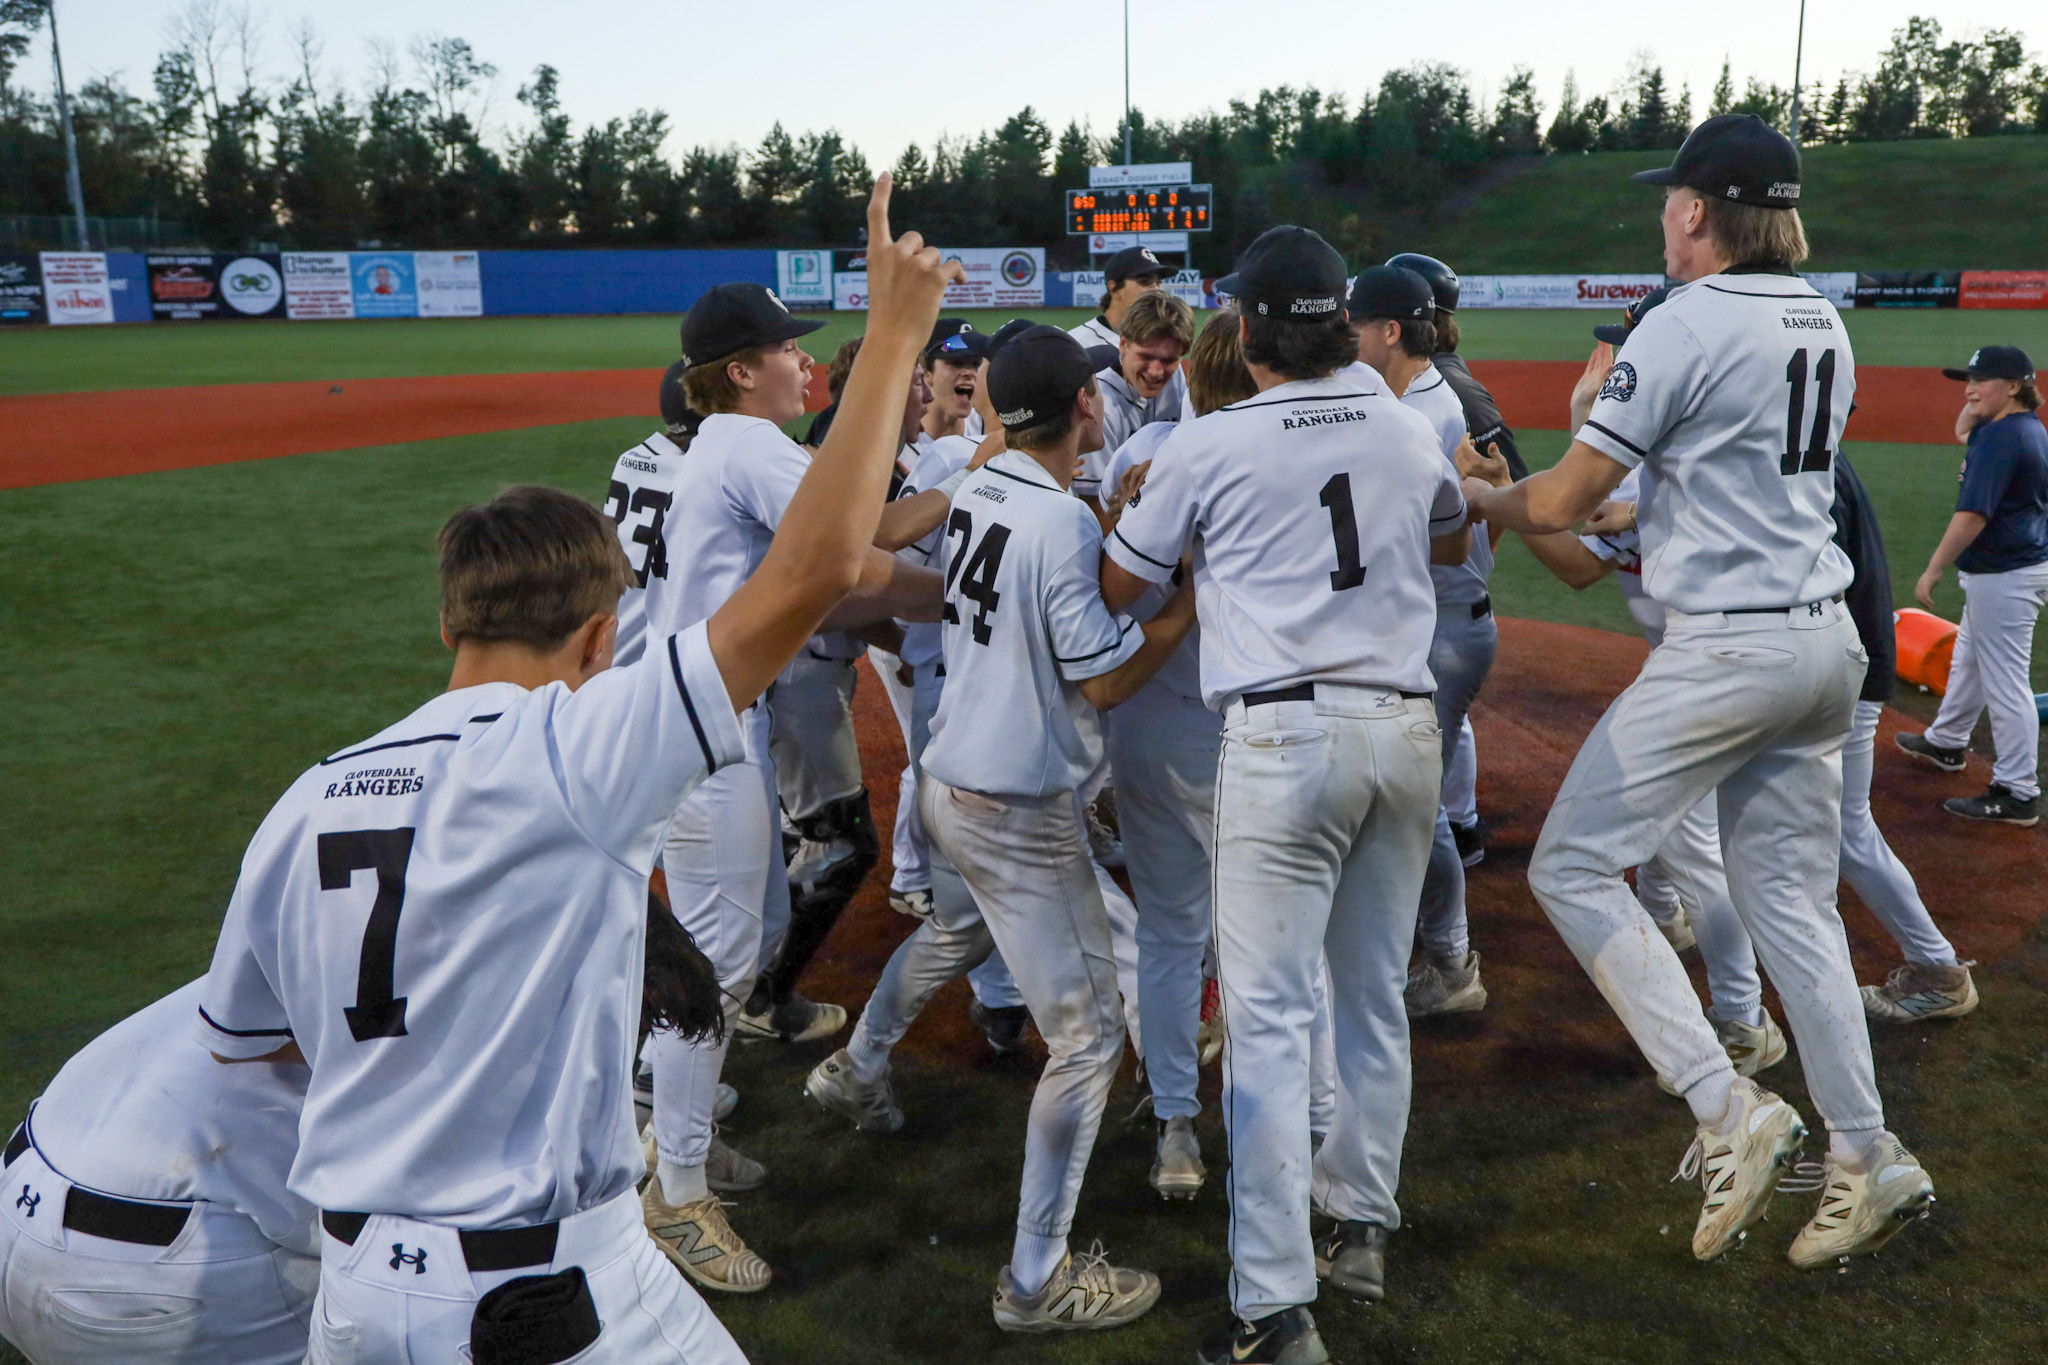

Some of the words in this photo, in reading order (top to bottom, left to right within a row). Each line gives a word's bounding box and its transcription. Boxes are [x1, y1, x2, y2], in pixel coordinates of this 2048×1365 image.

[786, 286, 824, 296] PRIME
[1290, 301, 1337, 314] RANGERS
[1295, 296, 1335, 305] CLOVERDALE
[1781, 317, 1833, 330] RANGERS
[1292, 406, 1350, 416] CLOVERDALE
[1780, 348, 1836, 476] 11
[1282, 410, 1367, 430] RANGERS
[972, 487, 1008, 504] RANGERS
[1320, 473, 1367, 592] 1
[942, 507, 1012, 647] 24
[345, 767, 416, 780] CLOVERDALE
[324, 776, 424, 799] RANGERS
[317, 827, 416, 1043] 7
